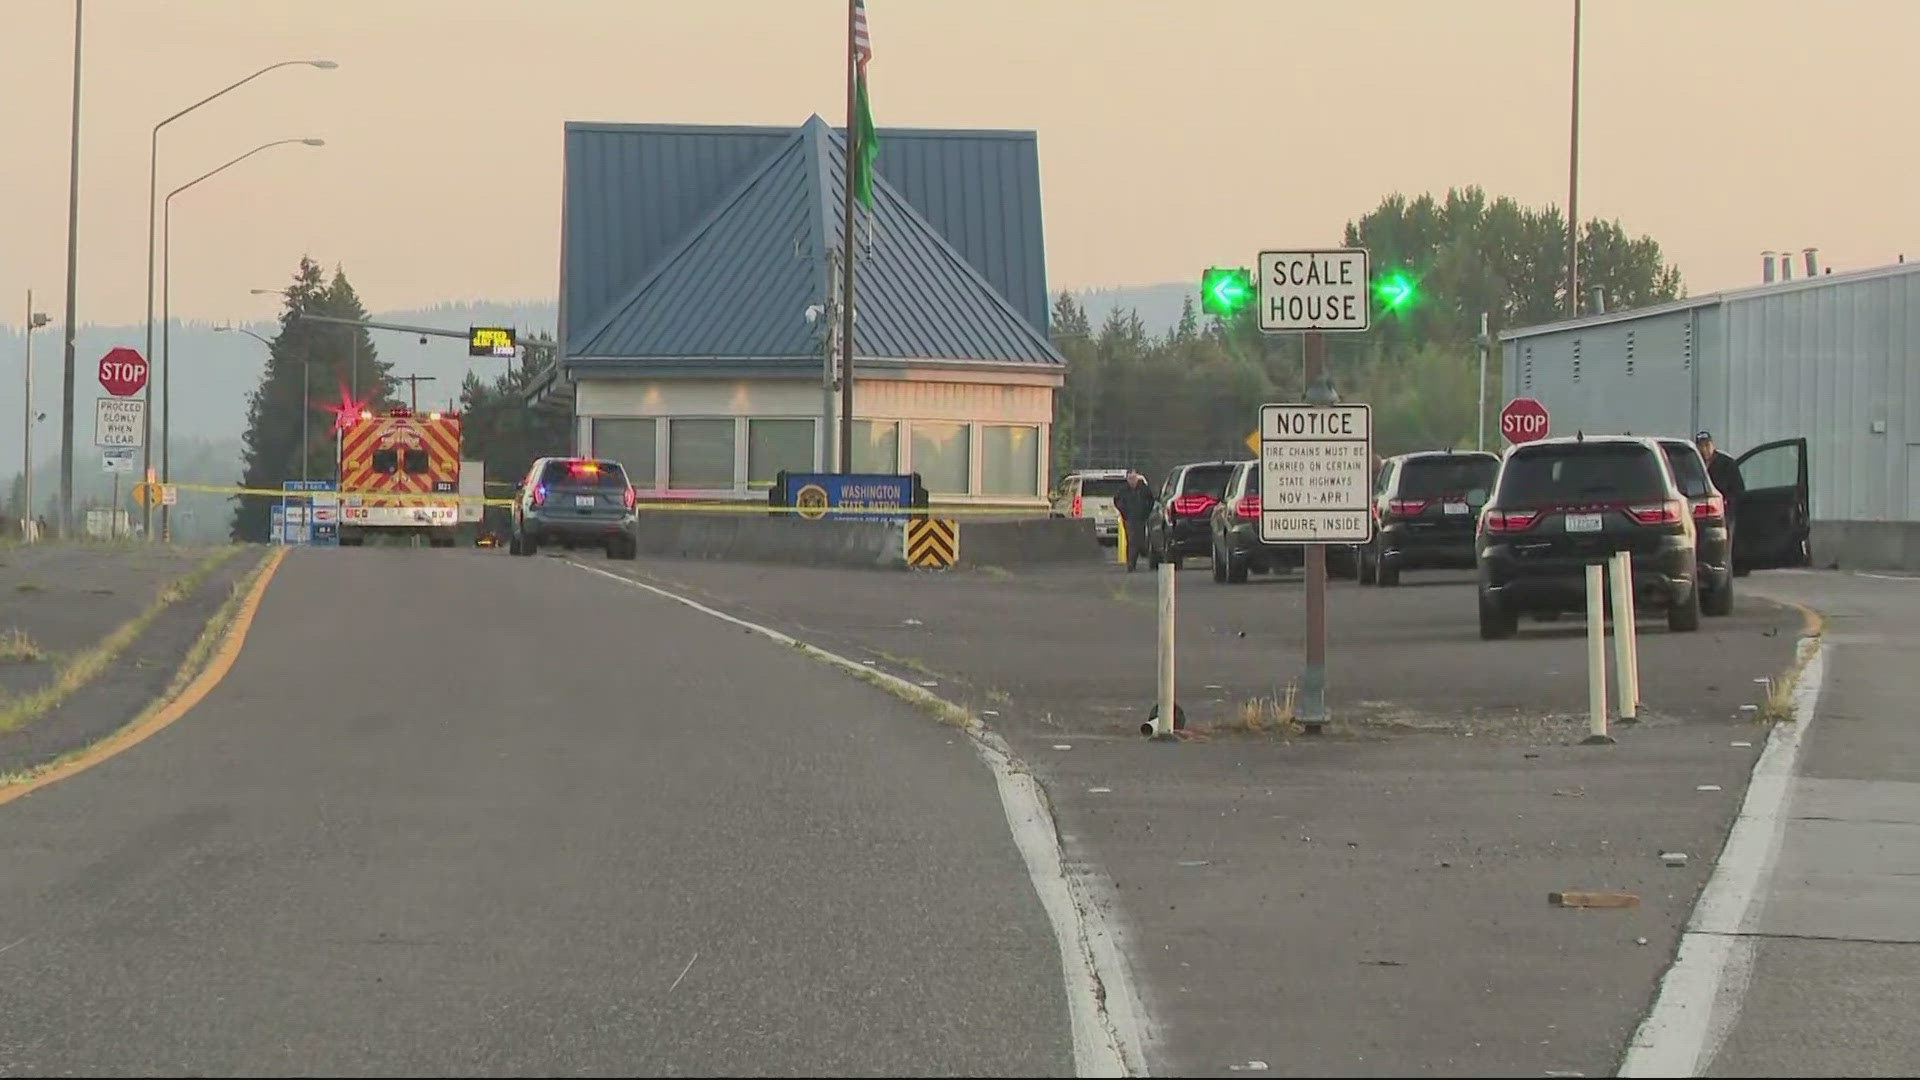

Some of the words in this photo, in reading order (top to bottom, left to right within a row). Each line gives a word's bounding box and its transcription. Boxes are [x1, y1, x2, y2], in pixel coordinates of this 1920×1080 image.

[1273, 260, 1352, 285] SCALE
[1271, 295, 1356, 321] HOUSE
[101, 363, 145, 382] STOP
[100, 402, 141, 412] PROCEED
[103, 413, 137, 422] SLOWLY
[1277, 413, 1352, 434] NOTICE
[1503, 413, 1546, 433] STOP
[107, 424, 132, 433] WHEN
[104, 434, 134, 444] CLEAR
[1266, 447, 1284, 457] TIRE
[1289, 447, 1320, 457] CHAINS
[1325, 447, 1348, 457] MUST
[1353, 447, 1364, 456] BE
[1268, 462, 1304, 472] CARRIED
[1310, 462, 1321, 471] ON
[1326, 461, 1361, 471] CERTAIN
[1279, 477, 1304, 487] STATE
[1309, 476, 1352, 487] HIGHWAYS
[841, 485, 900, 499] WASHINGTON
[1279, 493, 1302, 504] NOV
[838, 501, 864, 514] STATE
[869, 501, 900, 514] PATROL
[1270, 518, 1316, 531] INQUIRE
[1323, 518, 1361, 531] INSIDE
